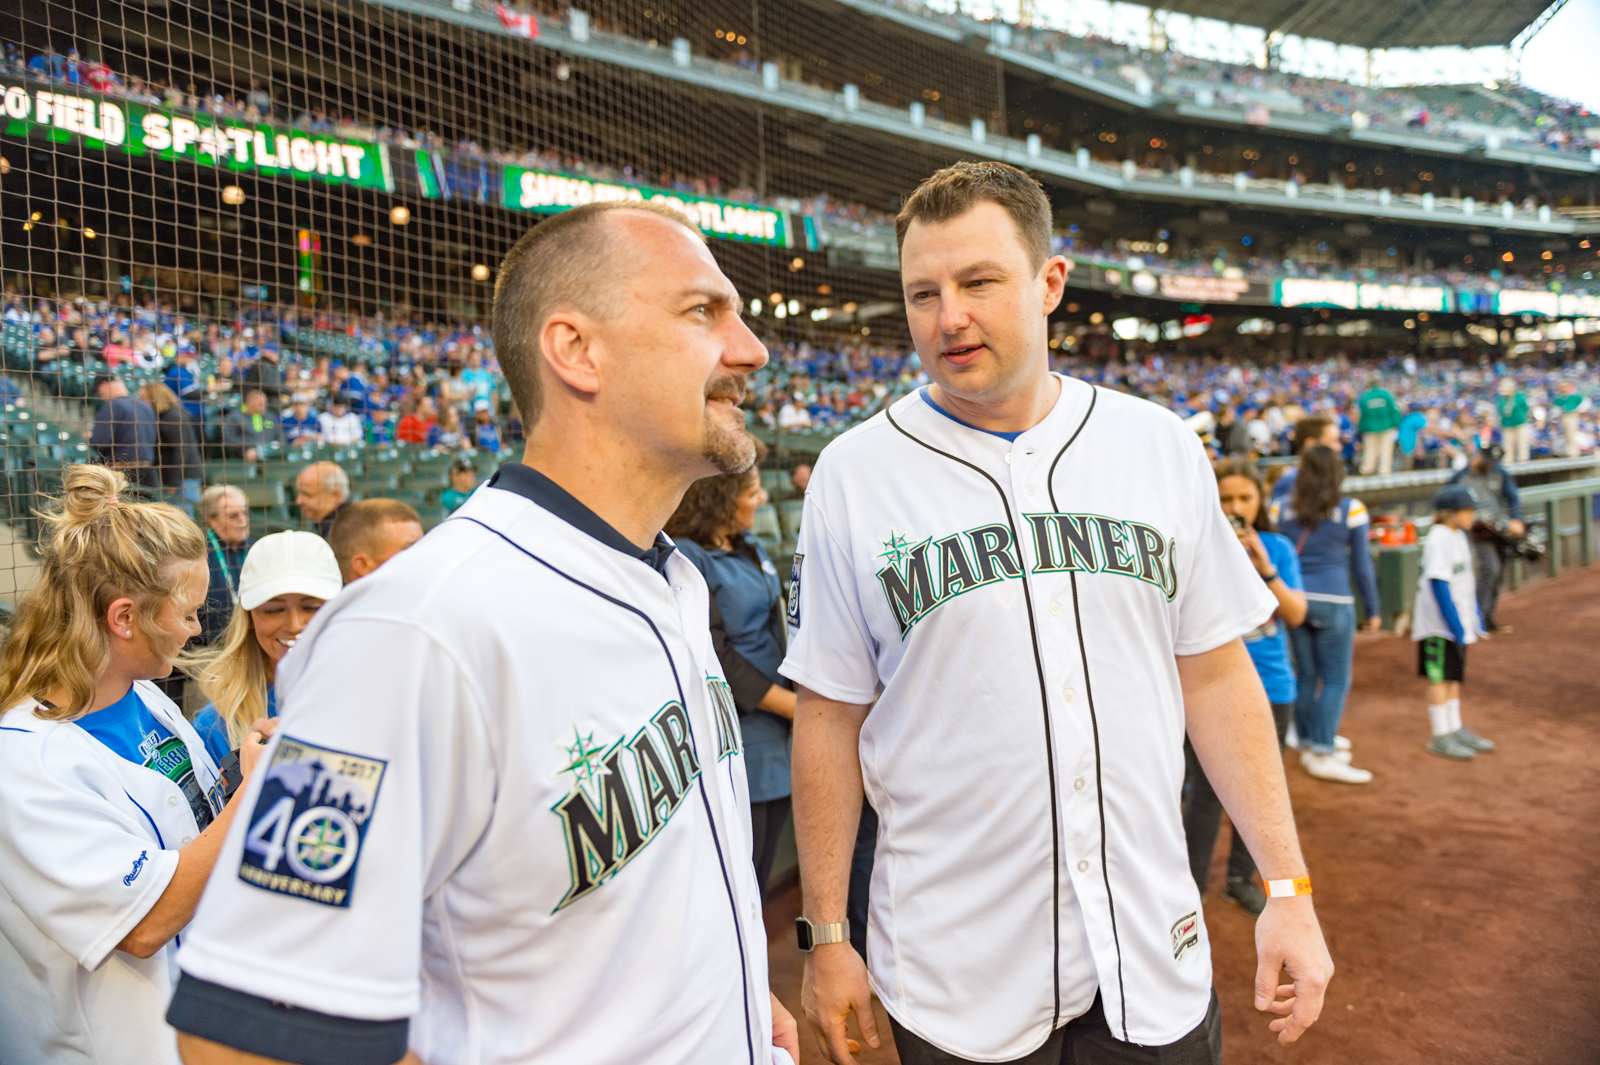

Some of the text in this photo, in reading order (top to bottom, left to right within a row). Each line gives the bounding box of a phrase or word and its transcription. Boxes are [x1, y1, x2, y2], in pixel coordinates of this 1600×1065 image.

[35, 90, 126, 146] FIELD
[141, 113, 365, 180] SPOTLIGHT
[338, 759, 377, 779] 2017
[123, 850, 148, 886] Rawlings
[245, 795, 360, 884] 40
